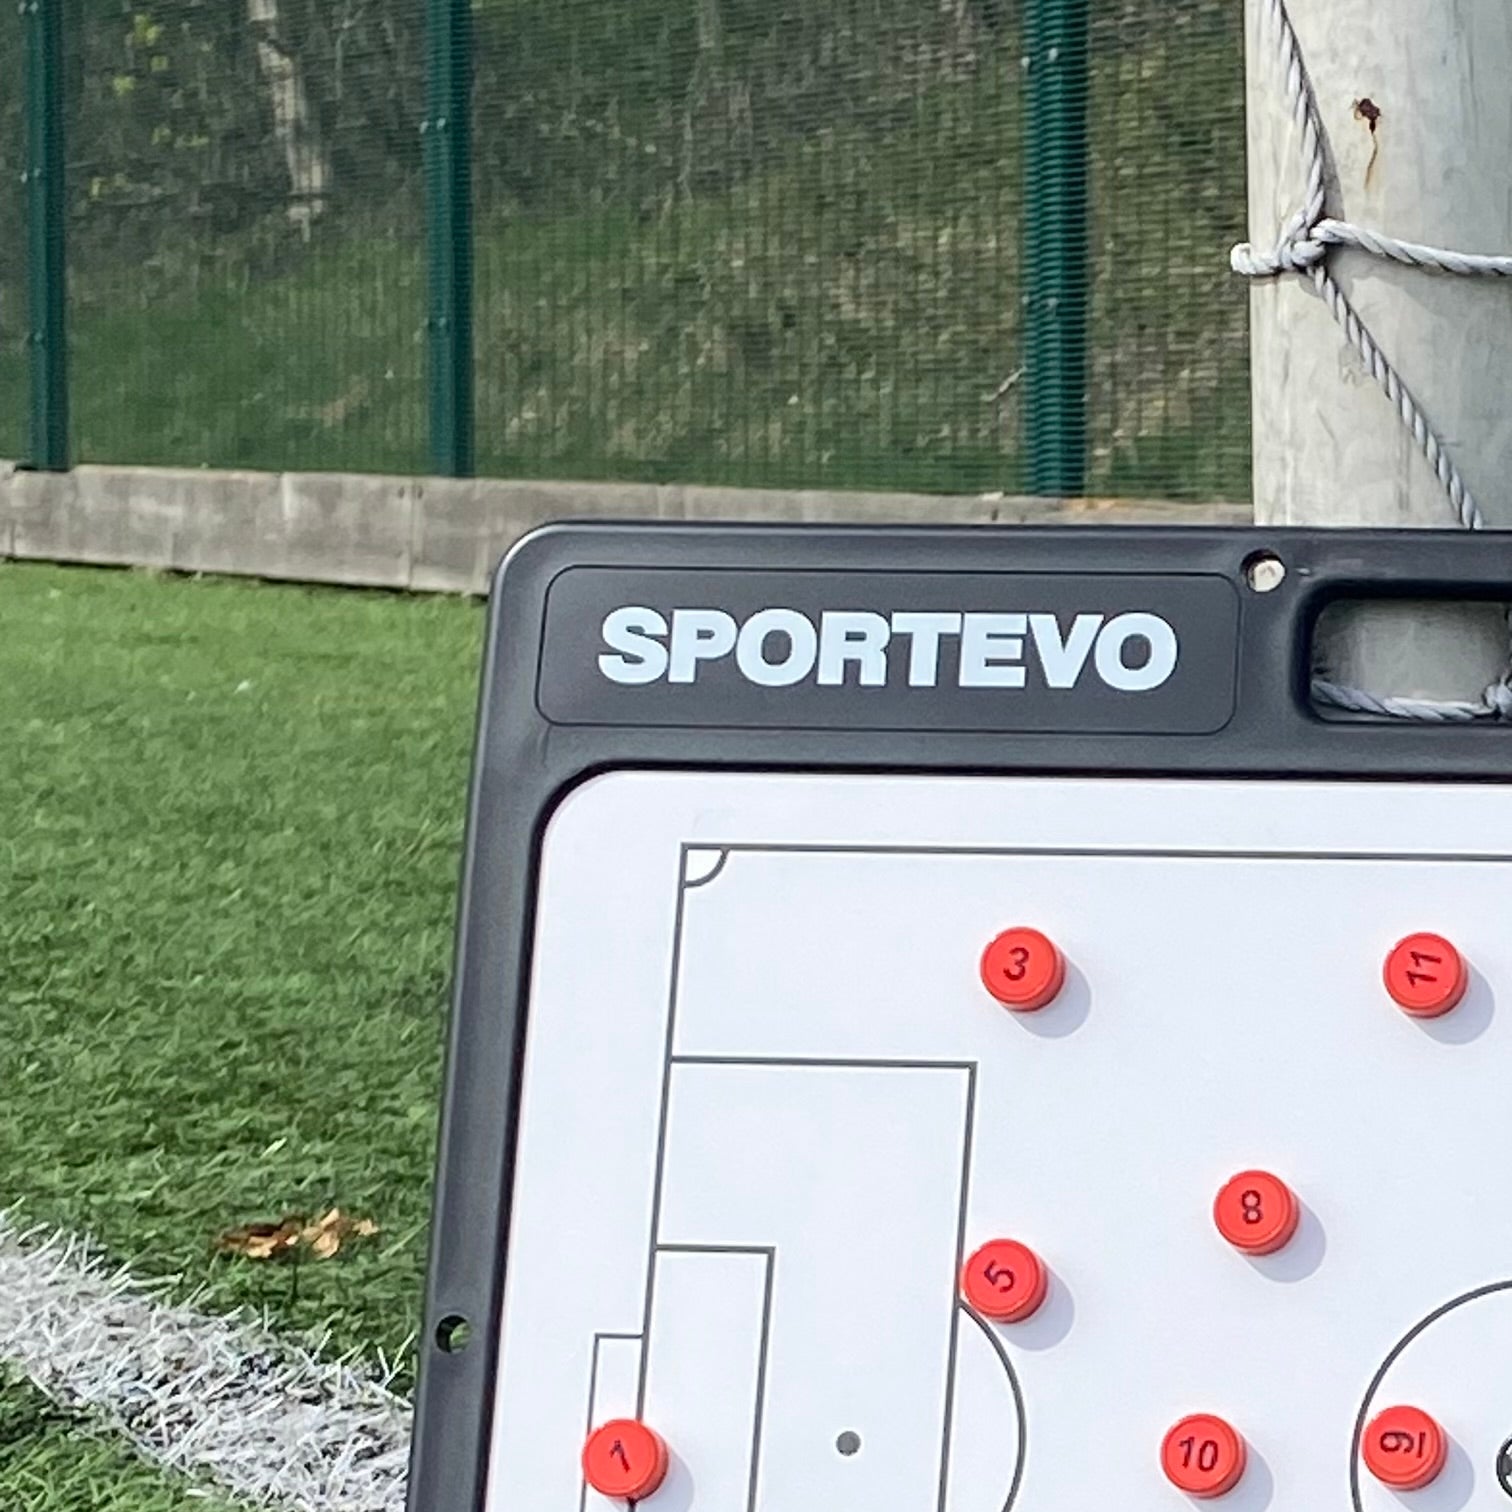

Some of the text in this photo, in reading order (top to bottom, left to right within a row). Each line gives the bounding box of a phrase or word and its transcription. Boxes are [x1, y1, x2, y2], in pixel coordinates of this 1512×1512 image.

[597, 606, 1178, 691] SPORTEVO
[1002, 946, 1031, 982] 3
[1404, 950, 1443, 988] 11
[1240, 1188, 1264, 1226] 8
[982, 1260, 1016, 1293] 5
[1177, 1435, 1220, 1474] 10
